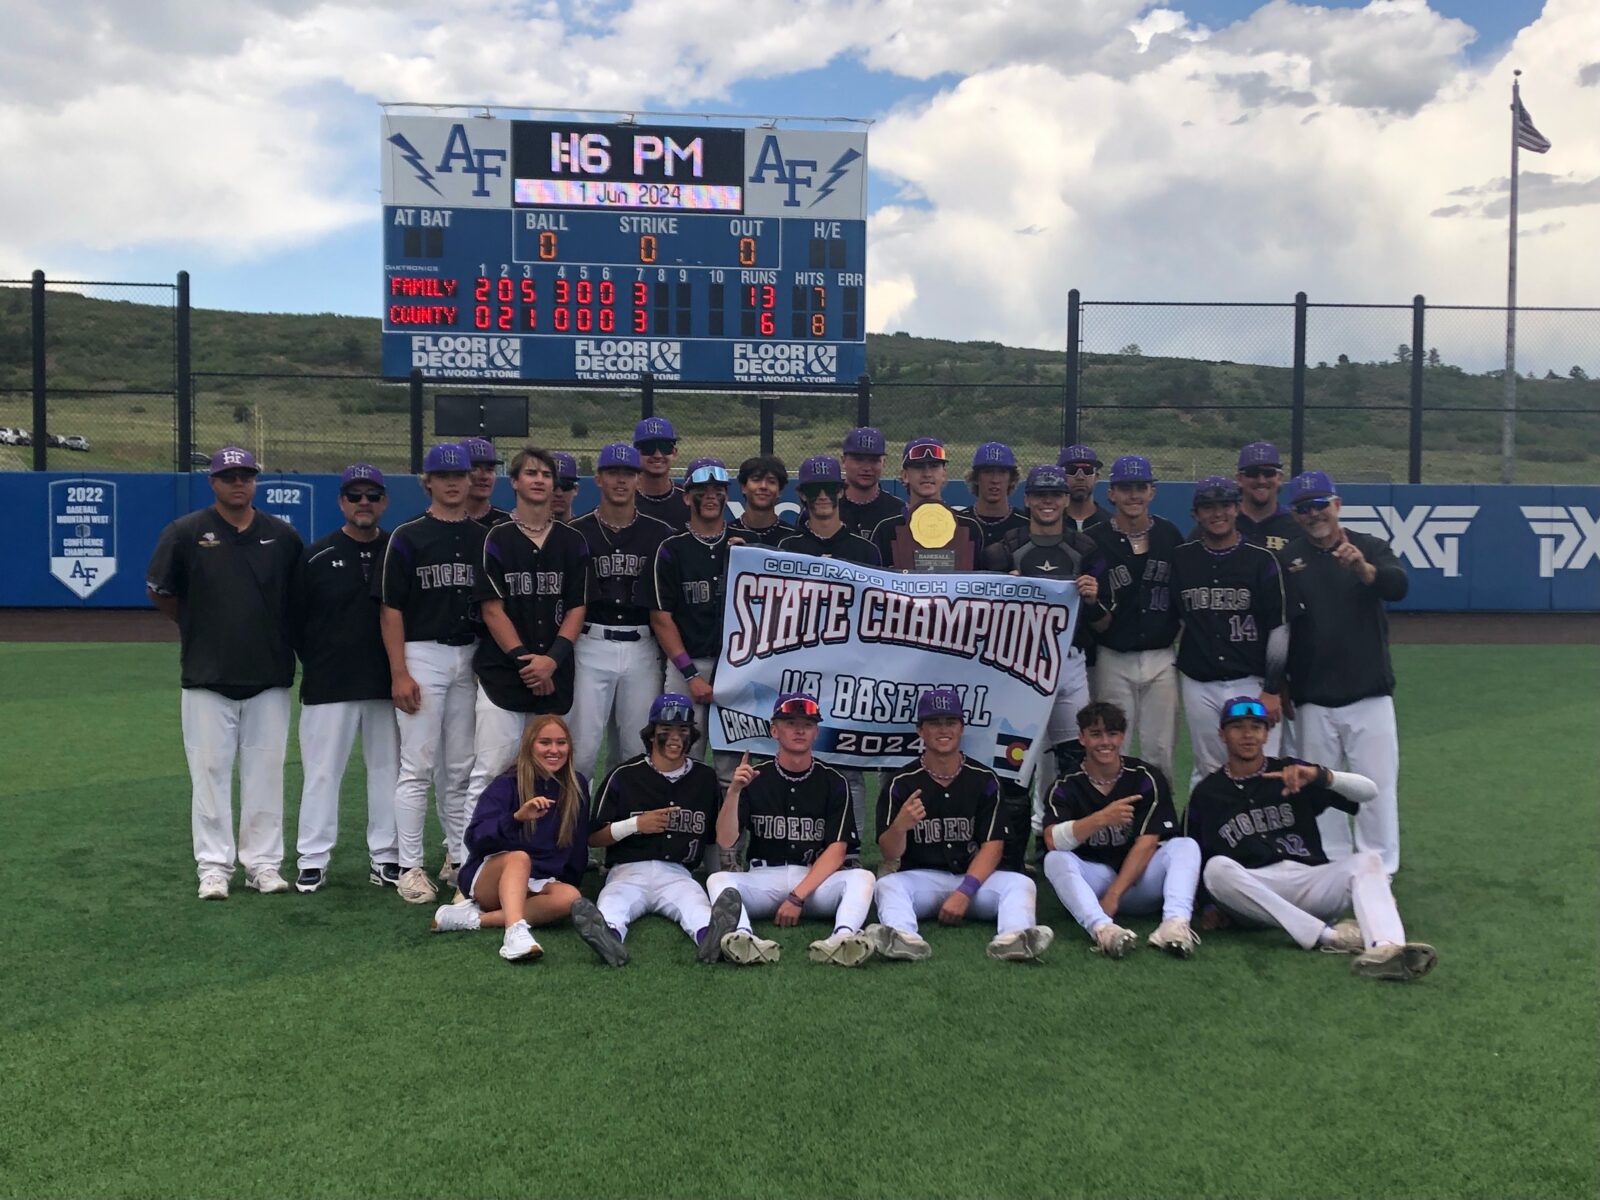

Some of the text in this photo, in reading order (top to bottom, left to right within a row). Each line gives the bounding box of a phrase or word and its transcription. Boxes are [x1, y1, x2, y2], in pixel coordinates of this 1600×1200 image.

[435, 123, 507, 197] AF
[633, 135, 704, 177] PM
[749, 134, 817, 207] AF
[579, 183, 681, 205] 1 Jun 2024
[394, 209, 453, 227] AT BAT
[526, 213, 569, 231] BALL
[619, 217, 678, 235] STRIKE
[729, 219, 764, 236] OUT
[813, 221, 842, 240] H/E
[539, 231, 556, 259] 0
[639, 235, 657, 263] 0
[739, 237, 756, 265] 0
[479, 263, 864, 287] 1 2 3 4 5 6 7 8 9 10 RUNS HITS ERR
[391, 277, 825, 309] FAMILY 2 0 5 3 0 0 3 13 7
[389, 304, 825, 336] COUNTY 0 2 1 0 0 0 3 6 8
[412, 335, 521, 369] FLOOR &
[412, 351, 487, 368] DECOR
[575, 339, 681, 372] FLOOR &
[575, 355, 649, 372] DECOR
[733, 343, 837, 376] FLOOR &
[443, 369, 477, 377] WOOD
[484, 370, 521, 378] STONE
[575, 372, 600, 380] TILE
[605, 372, 639, 380] WOOD
[733, 358, 805, 375] DECOR
[734, 375, 757, 383] TILE
[763, 375, 796, 383] WOOD
[67, 486, 103, 503] 2022
[266, 488, 301, 504] 2022
[69, 559, 98, 587] AF
[764, 558, 1047, 600] COLORADO HIGH SCHOOL
[1181, 586, 1251, 612] TIGERS
[727, 572, 1070, 696] STATE CHAMPIONS
[1228, 614, 1258, 642] 14
[721, 708, 768, 743] CHSAA
[836, 732, 926, 753] 2024
[751, 814, 826, 841] TIGERS
[1218, 802, 1296, 849] TIGERS
[1275, 832, 1311, 858] 12
